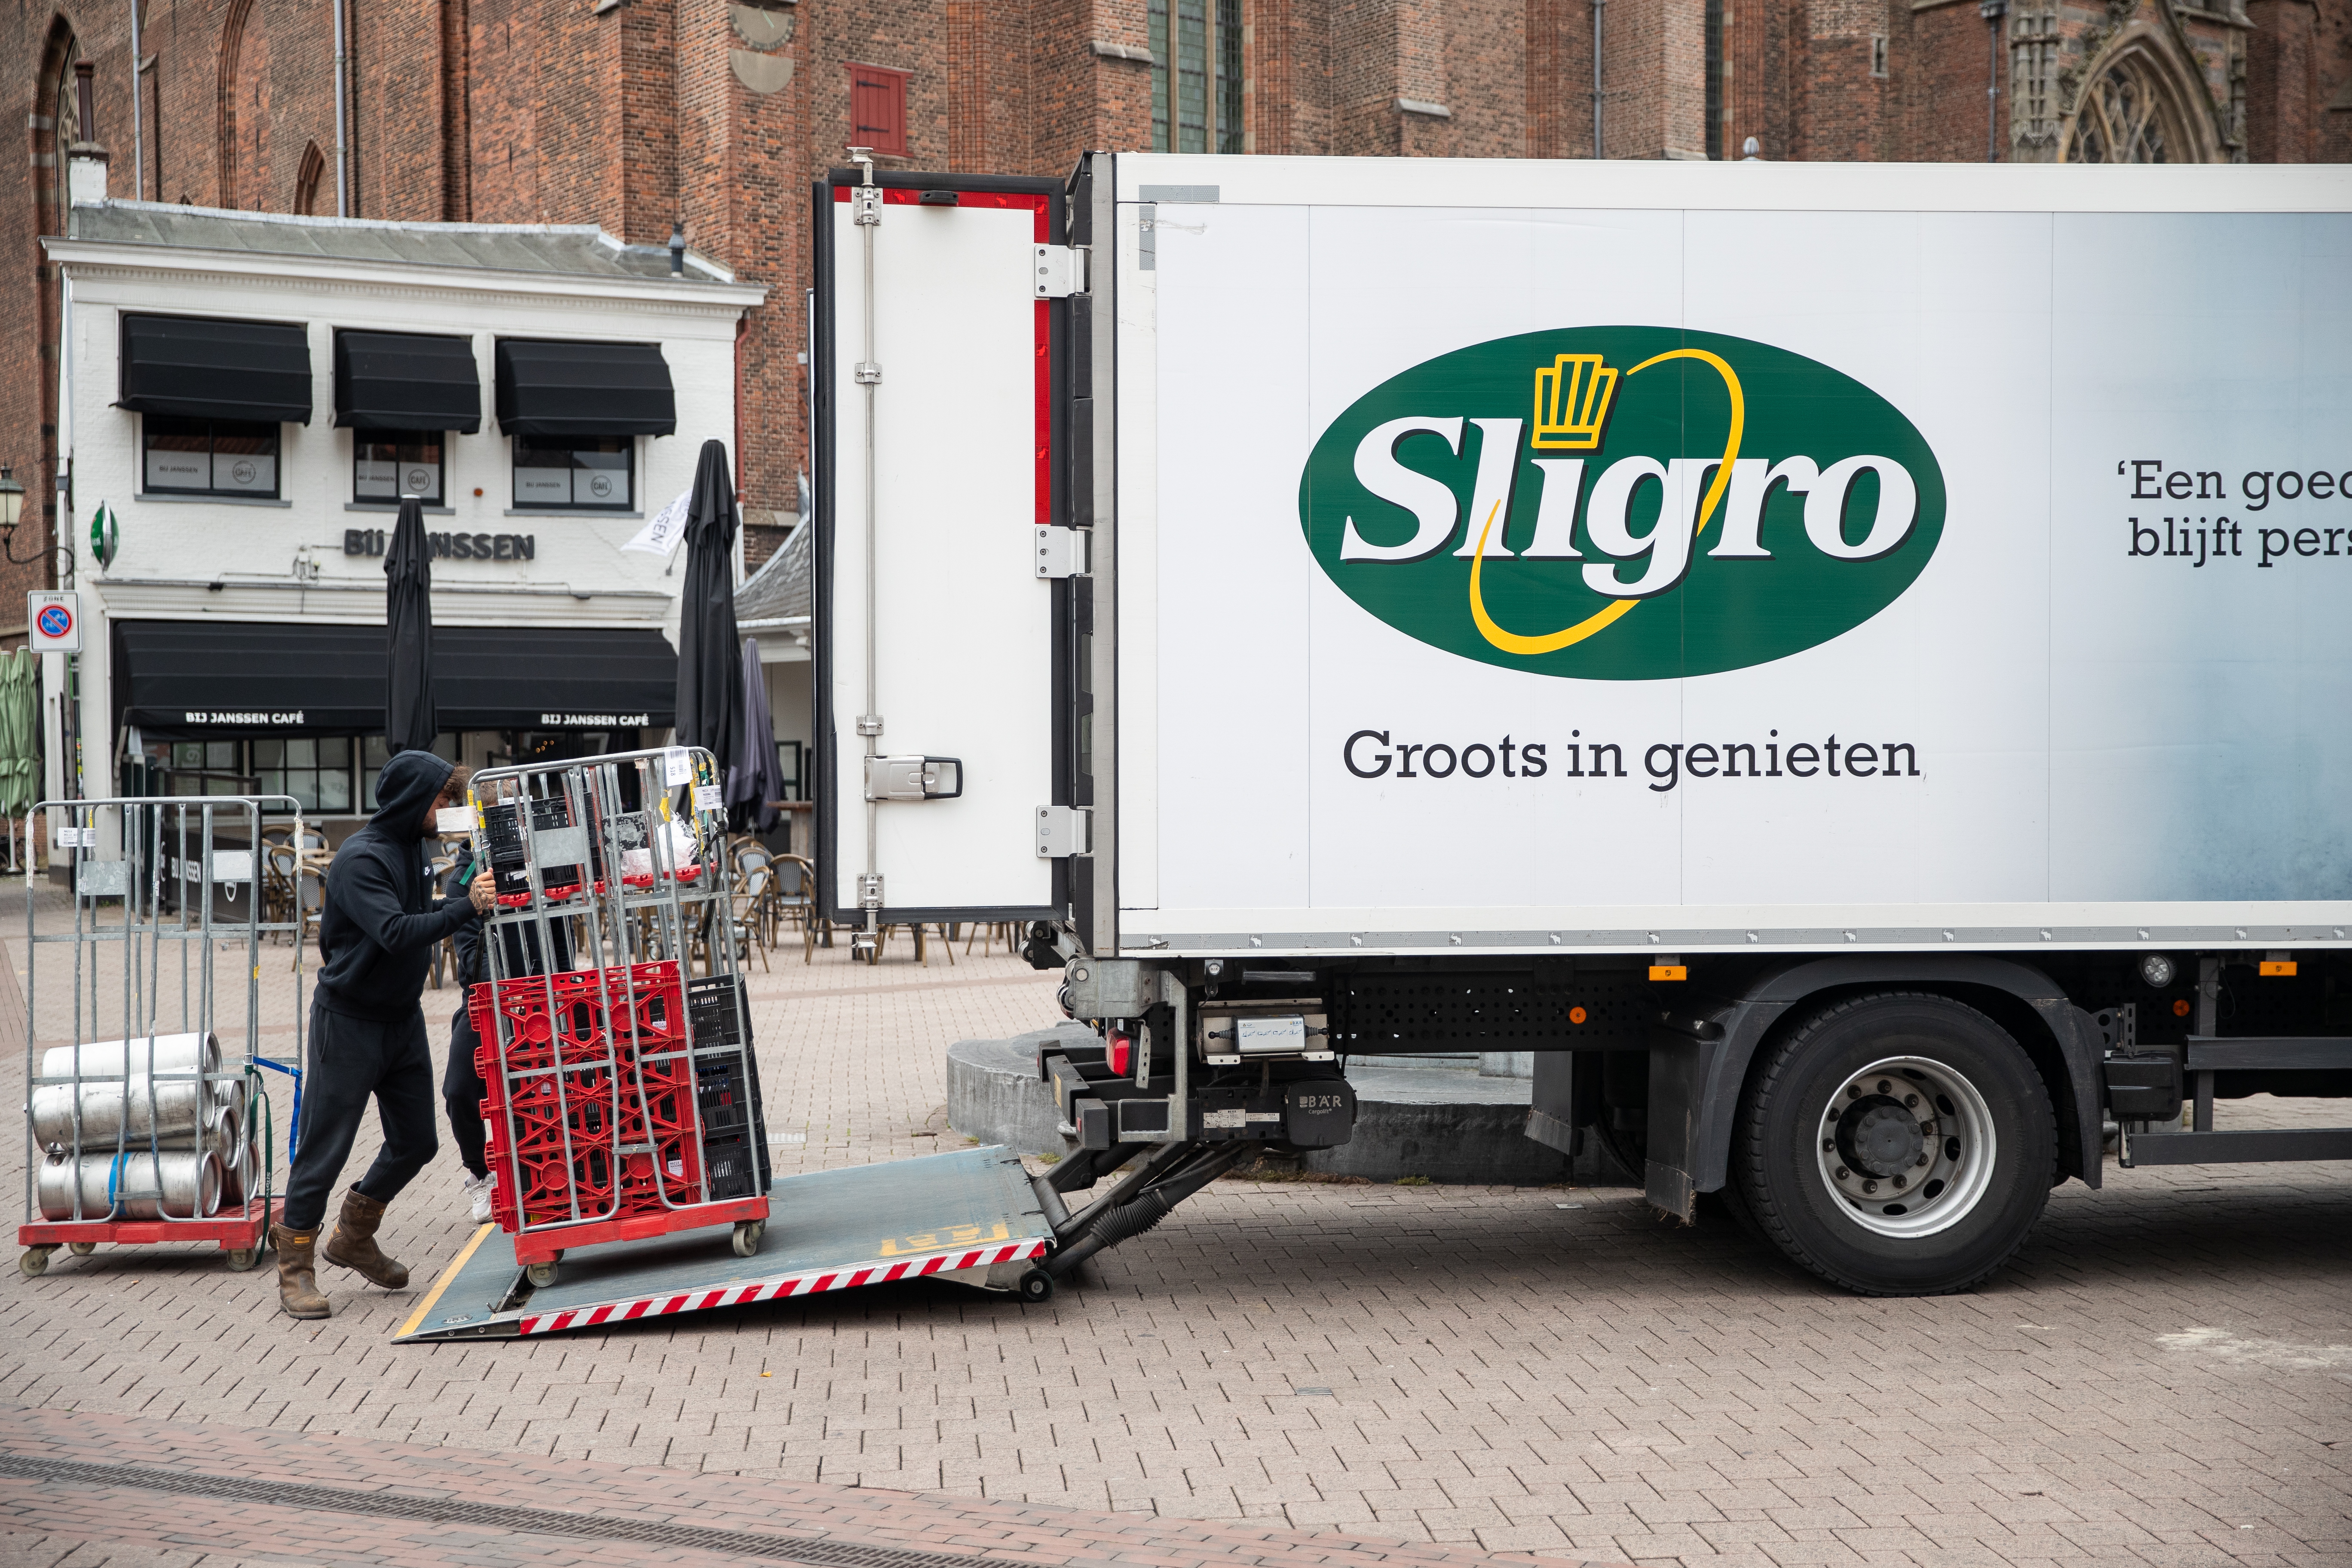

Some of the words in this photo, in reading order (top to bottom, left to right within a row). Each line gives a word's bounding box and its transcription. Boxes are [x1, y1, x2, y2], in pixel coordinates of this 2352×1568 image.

[1340, 416, 1918, 597] Sligro
[343, 528, 385, 557] BIJ
[429, 532, 535, 560] NSSEN
[2128, 516, 2242, 568] blijft
[2257, 527, 2352, 568] per
[186, 712, 207, 723] BIJ
[210, 713, 269, 724] JANSSEN
[271, 710, 304, 724] CAFÉ
[541, 714, 561, 725] BIJ
[563, 714, 617, 726] JANSSEN
[619, 713, 649, 726] CAFÉ
[1343, 729, 1548, 779] Groots
[1567, 729, 1628, 777] in
[1644, 729, 1920, 792] genieten
[1309, 1095, 1342, 1107] BÄR
